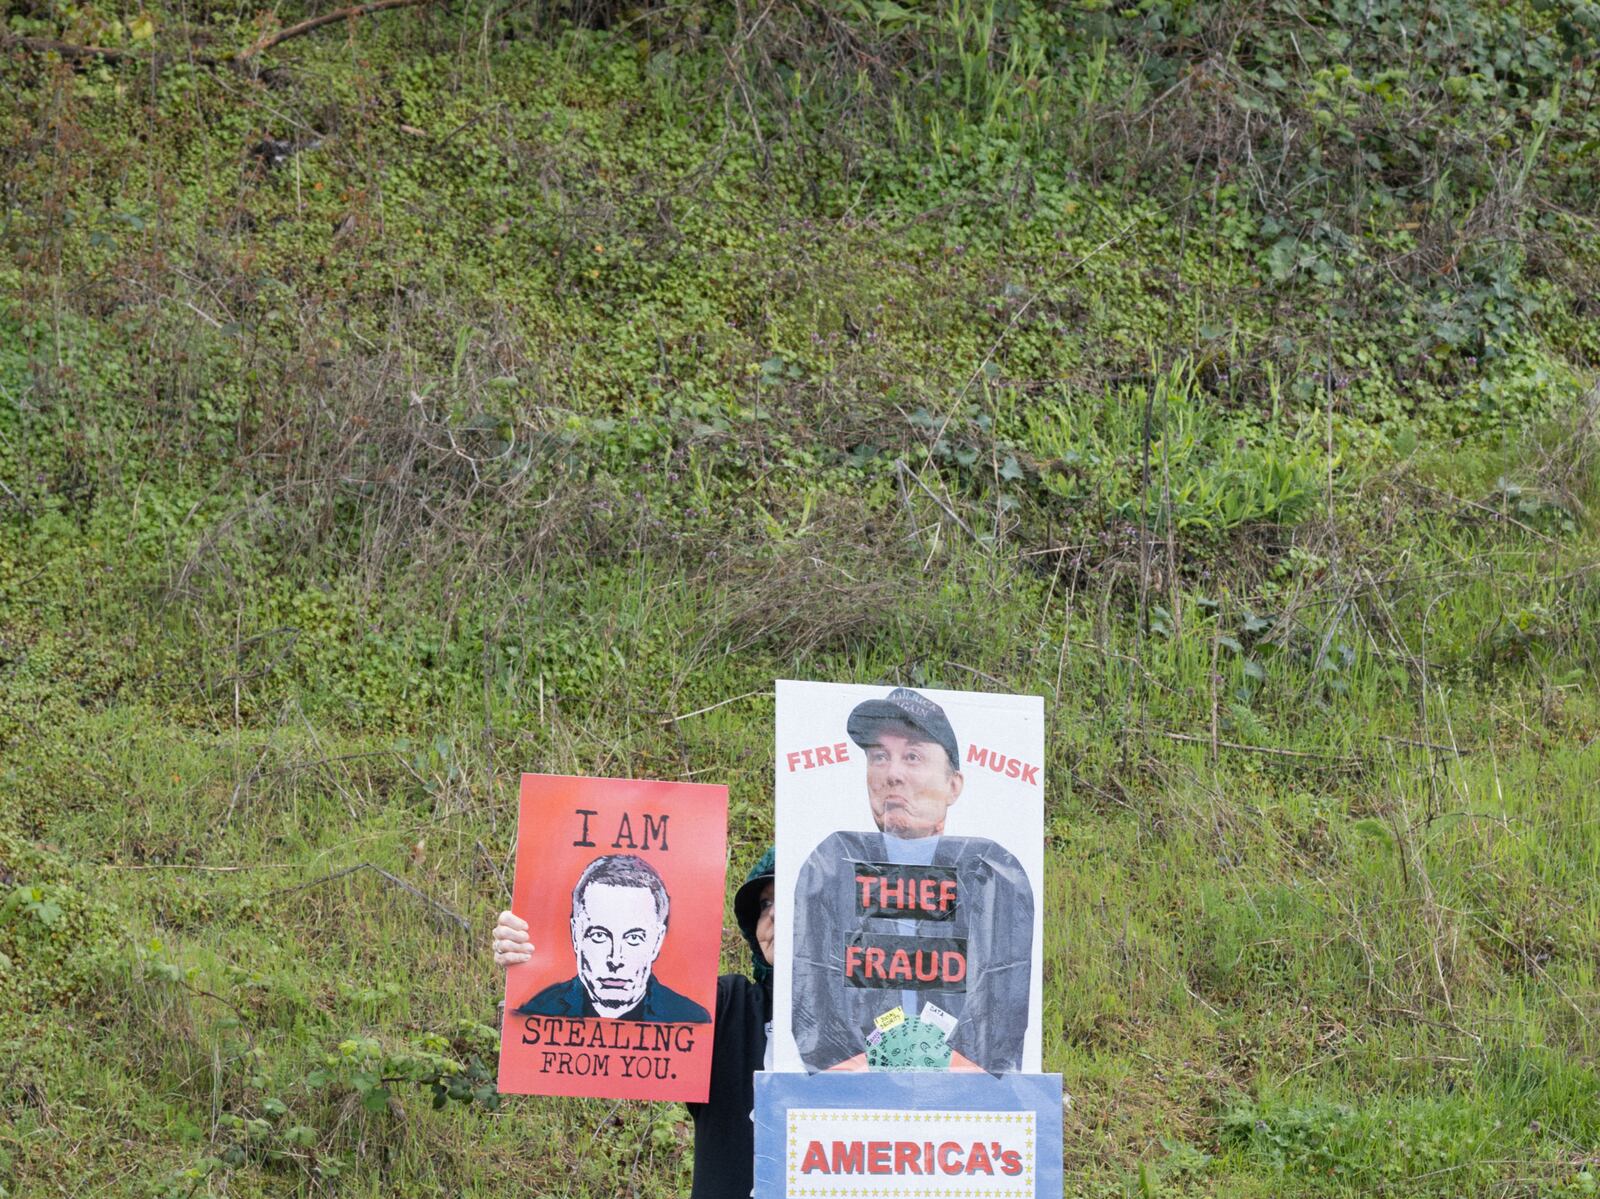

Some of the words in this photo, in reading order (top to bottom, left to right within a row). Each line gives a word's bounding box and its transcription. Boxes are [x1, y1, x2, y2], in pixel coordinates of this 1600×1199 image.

[786, 742, 850, 773] FIRE
[966, 744, 1041, 786] MUSK
[573, 809, 598, 847] I
[612, 812, 670, 851] AM
[855, 876, 958, 913] THIEF
[844, 946, 967, 983] FRAUD
[521, 1016, 695, 1052] STEALING
[539, 1051, 609, 1076] FROM
[620, 1056, 678, 1080] YOU.
[799, 1140, 1024, 1177] AMERICA's
